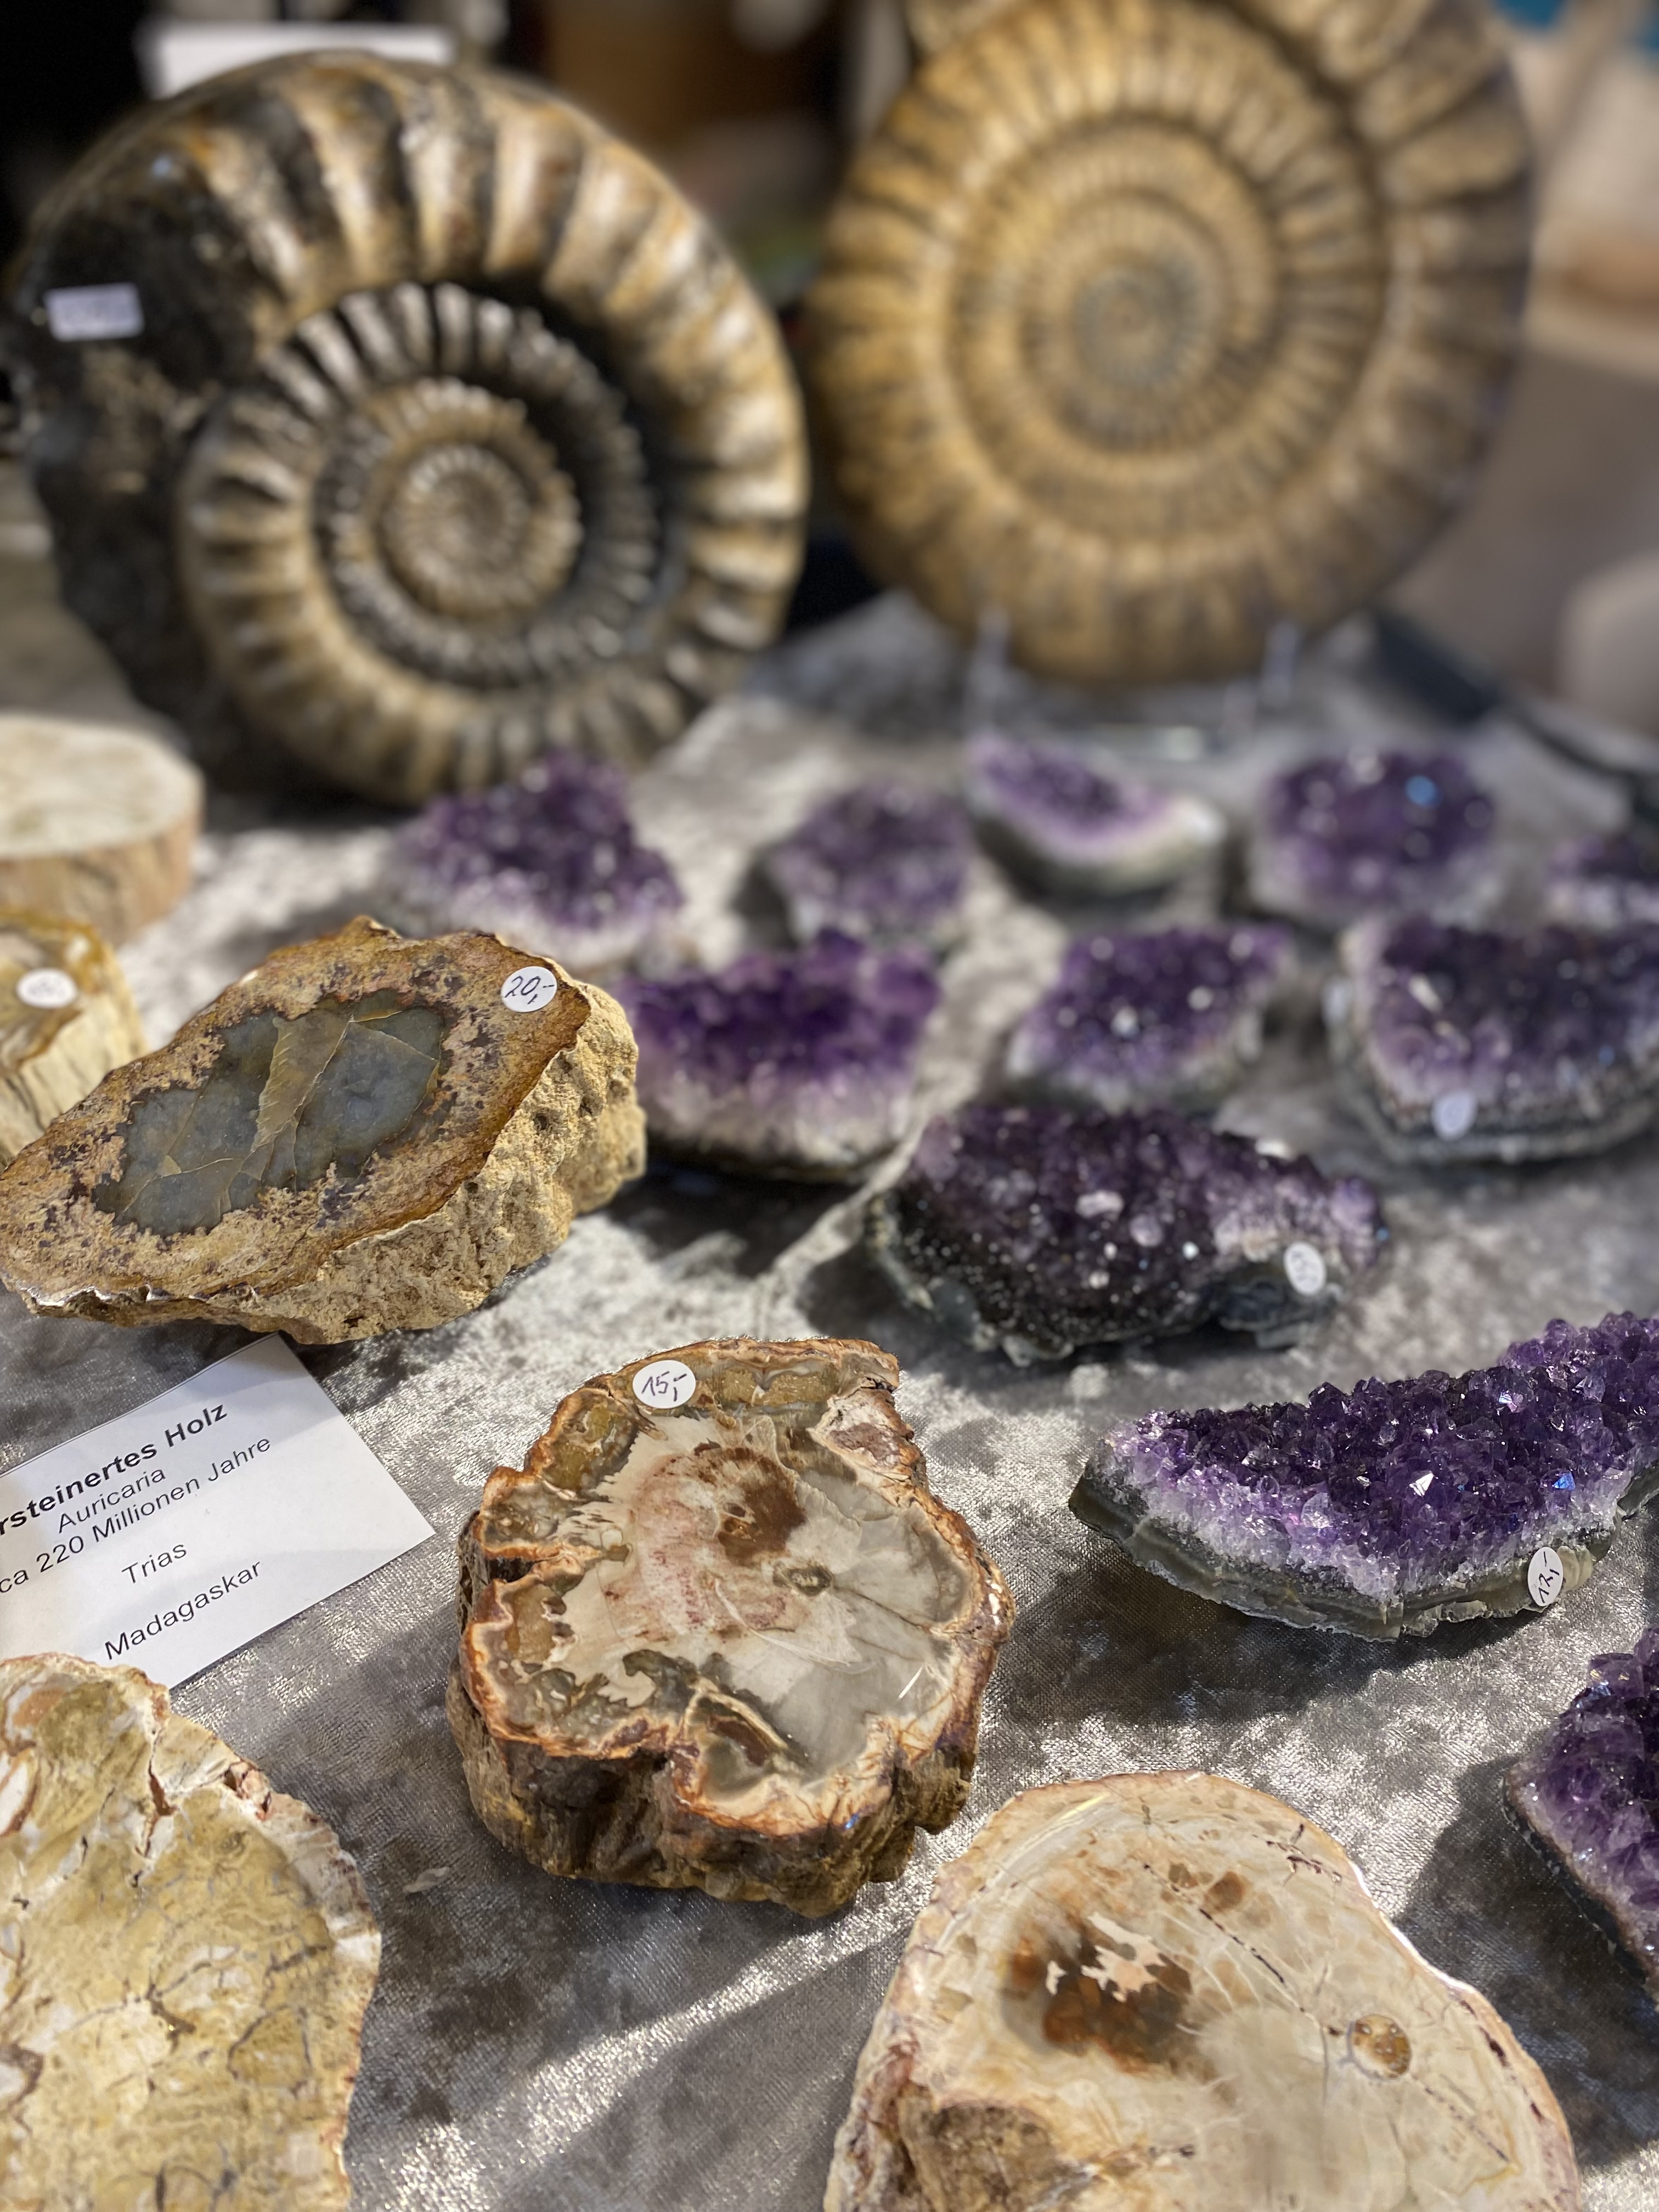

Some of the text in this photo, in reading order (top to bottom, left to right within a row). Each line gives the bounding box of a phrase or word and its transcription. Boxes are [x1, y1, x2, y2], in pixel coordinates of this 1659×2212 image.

[0, 1404, 228, 1536] rsteinertes Holz
[0, 1438, 270, 1593] ca 220 Millionen Jahre
[59, 1469, 166, 1534] Auricaria
[104, 1561, 261, 1660] Madagaskar
[121, 1544, 187, 1584] Trias
